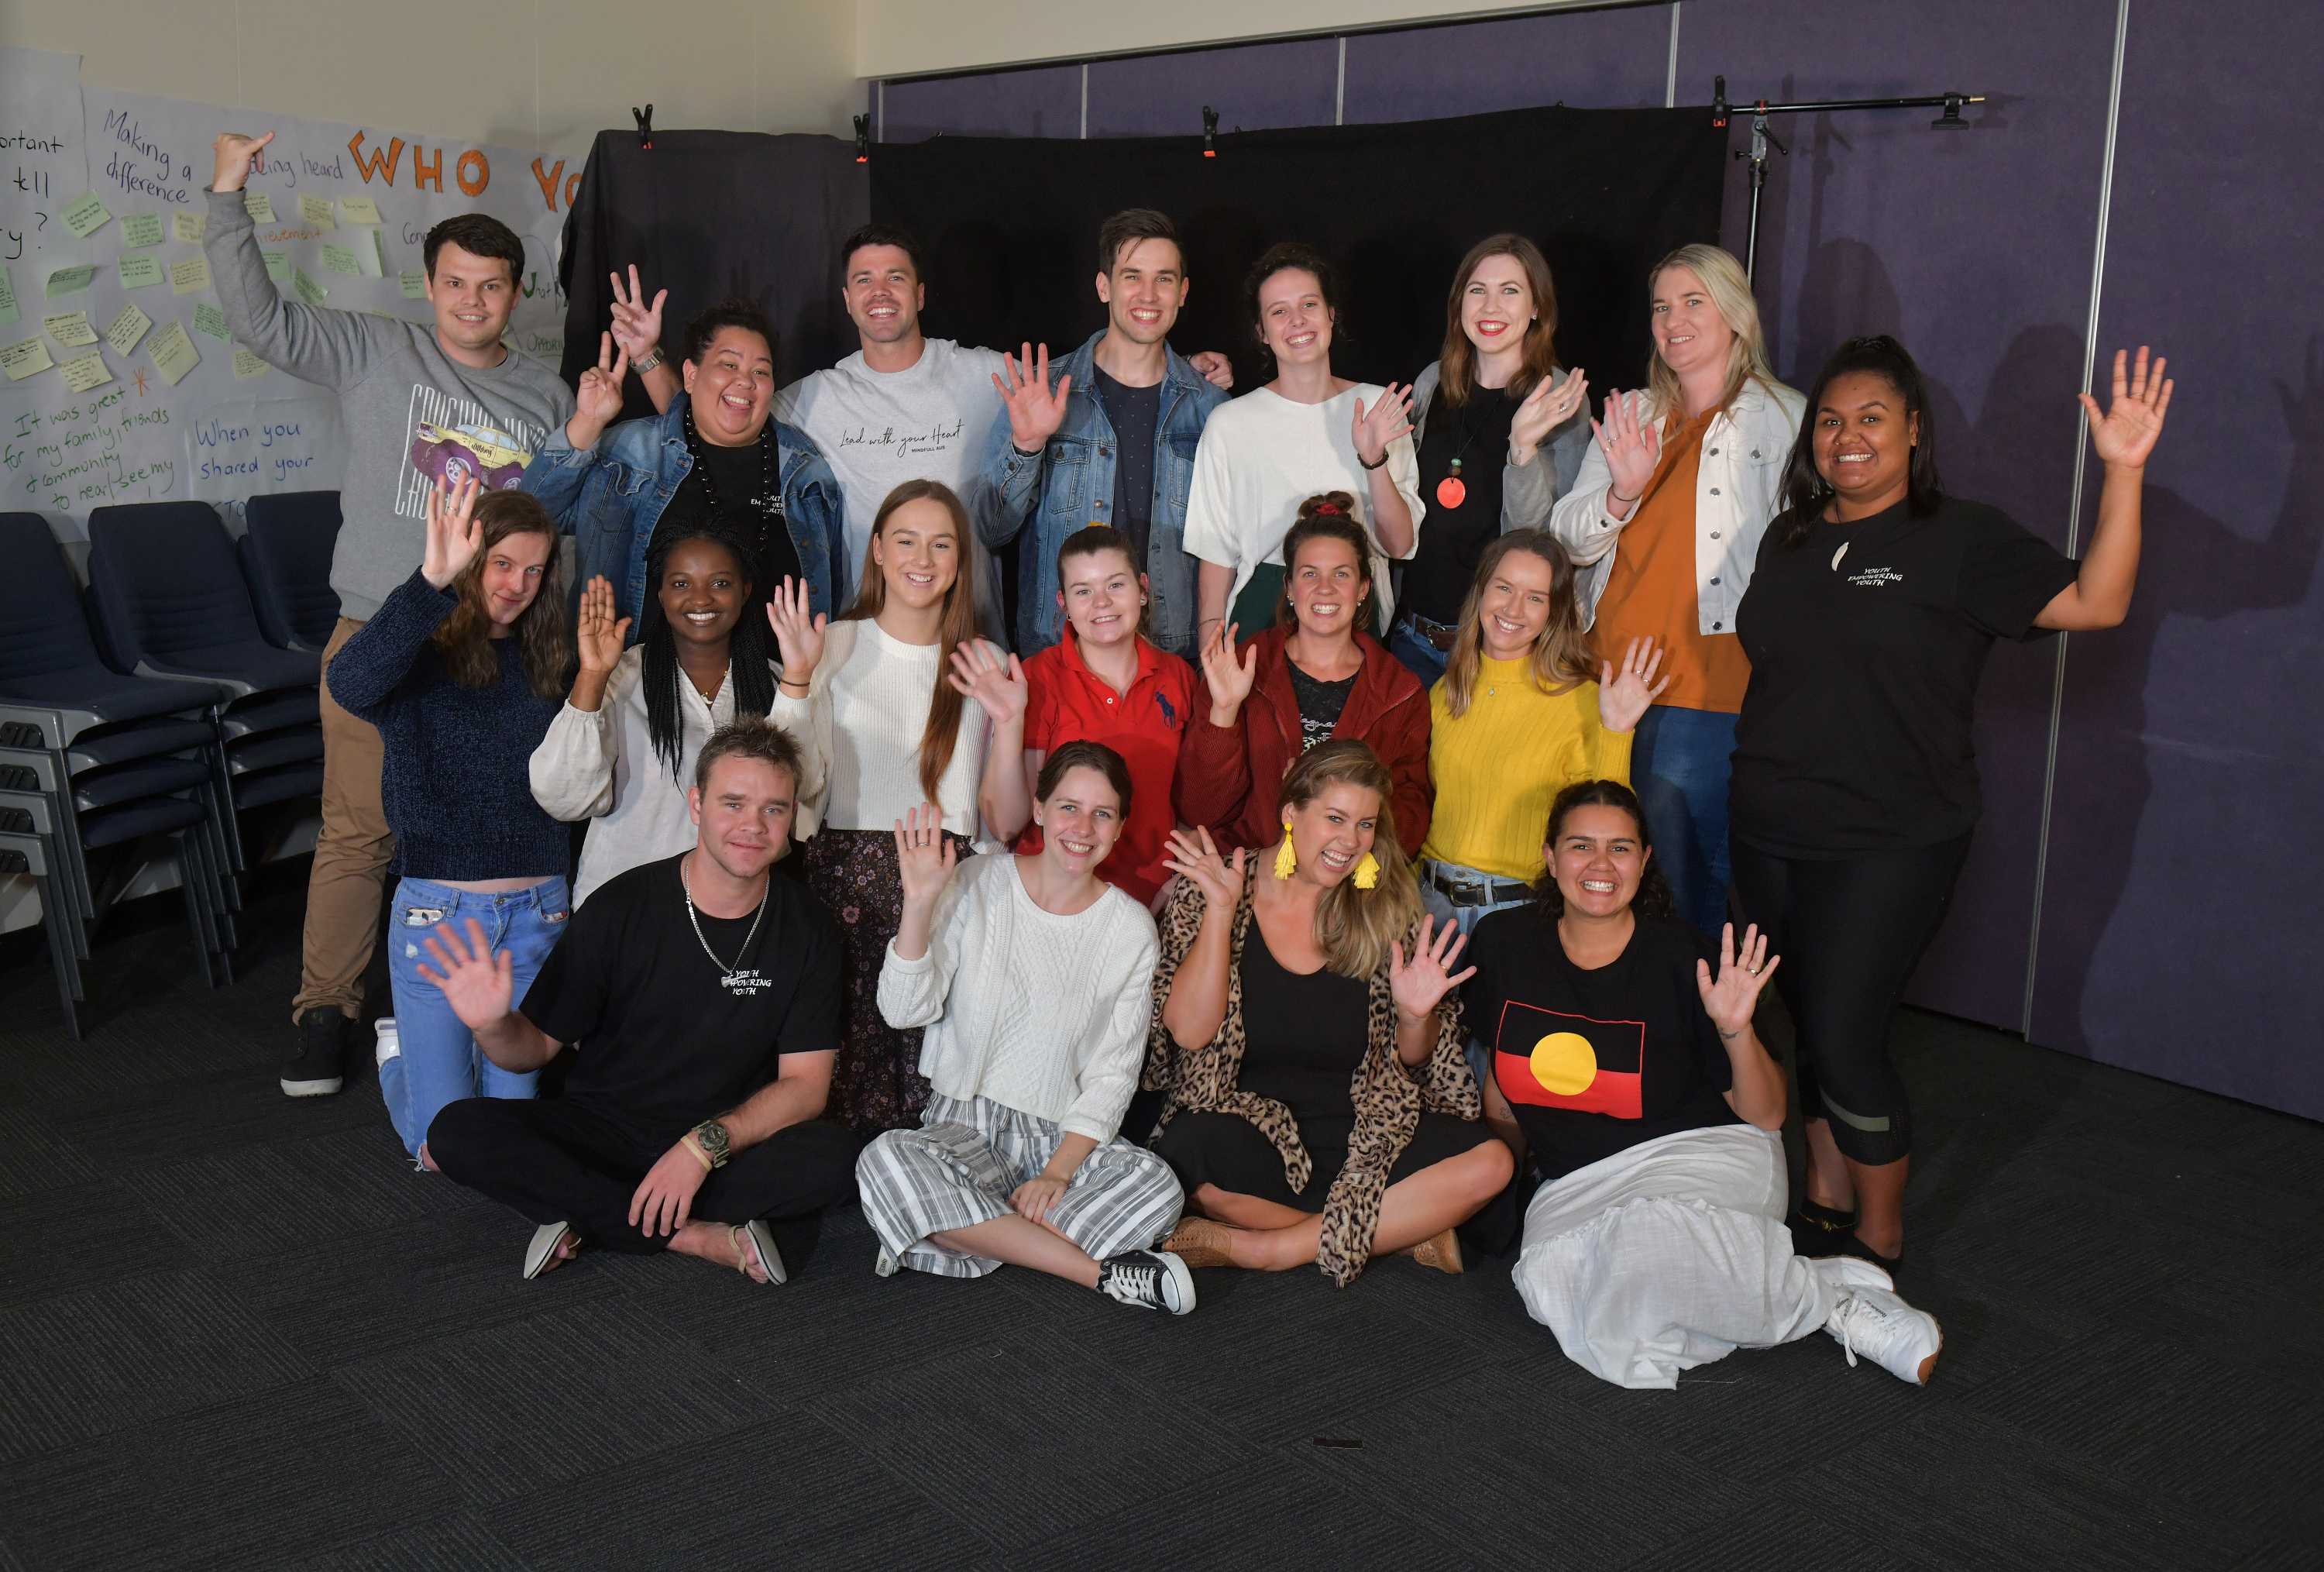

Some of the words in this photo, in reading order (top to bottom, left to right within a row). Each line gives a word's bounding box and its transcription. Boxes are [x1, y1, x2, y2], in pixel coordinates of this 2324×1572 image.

[104, 108, 170, 181] Making
[182, 165, 191, 181] a
[347, 130, 490, 198] WHO
[106, 151, 190, 203] difference
[299, 150, 344, 180] heard
[15, 410, 41, 439] It
[50, 406, 80, 425] was
[88, 386, 125, 424] great
[3, 444, 26, 472] for
[36, 444, 63, 468] my
[122, 407, 170, 432] friends
[195, 418, 249, 447] When
[260, 423, 301, 447] you
[840, 428, 865, 447] Lead
[869, 428, 896, 446] with
[897, 435, 927, 458] your
[930, 418, 965, 445] Heart
[43, 449, 122, 487] community
[150, 459, 174, 495] my
[200, 456, 260, 480] shared
[274, 457, 314, 481] your
[1847, 573, 1903, 582] EMPOWERING
